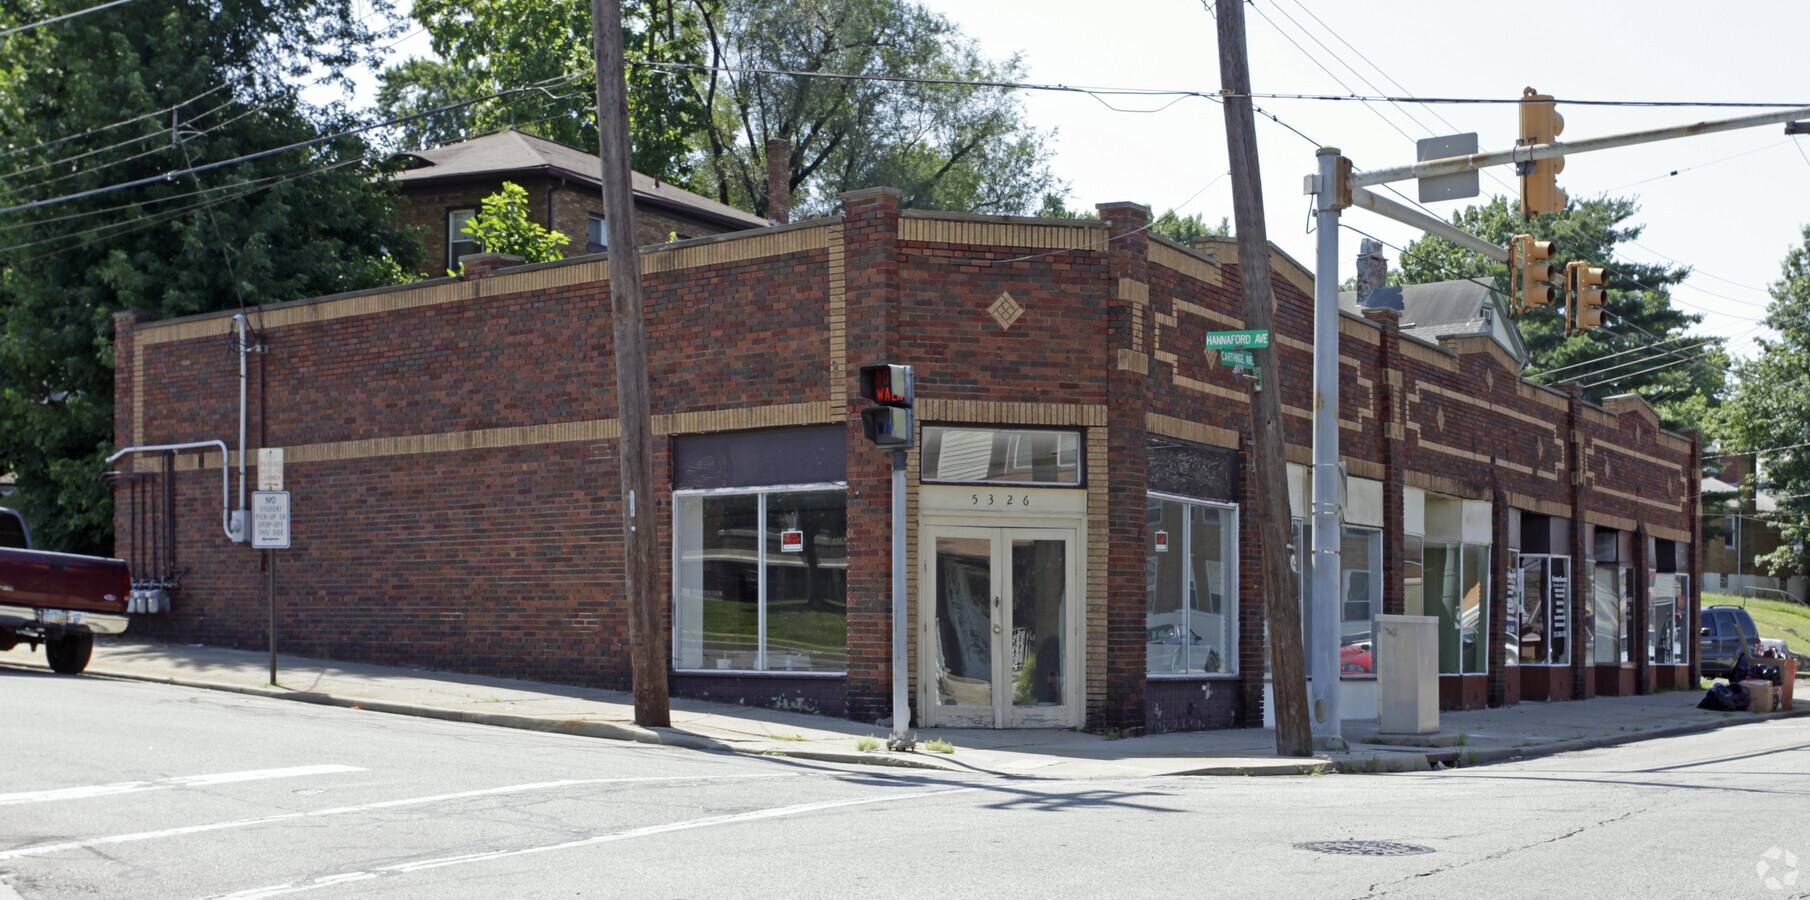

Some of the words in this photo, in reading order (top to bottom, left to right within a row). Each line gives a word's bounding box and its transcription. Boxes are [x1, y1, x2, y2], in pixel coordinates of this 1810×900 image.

[1206, 334, 1251, 345] HANNAFORD
[1255, 333, 1269, 344] AVE
[265, 496, 276, 505] NO
[972, 494, 1030, 506] 5326
